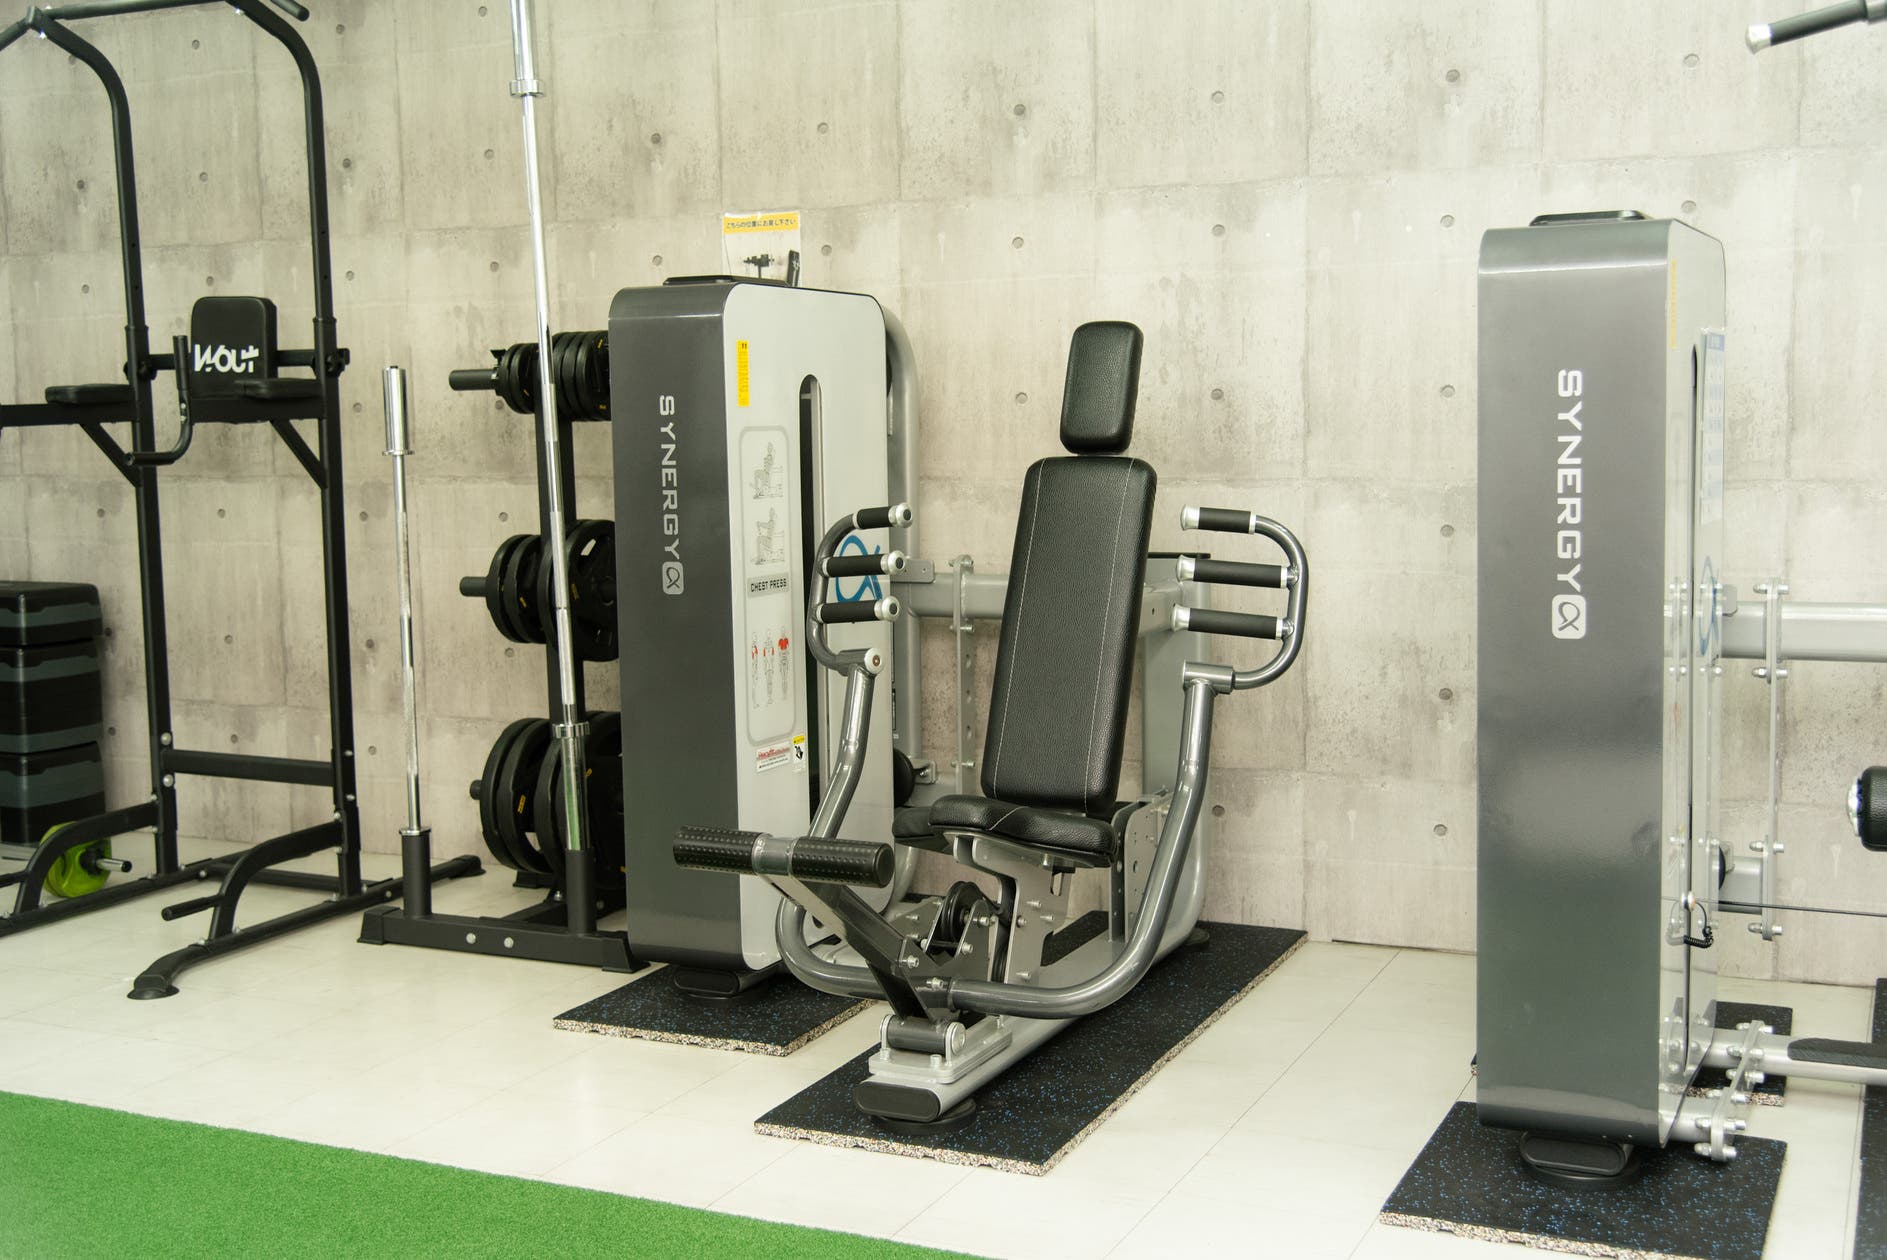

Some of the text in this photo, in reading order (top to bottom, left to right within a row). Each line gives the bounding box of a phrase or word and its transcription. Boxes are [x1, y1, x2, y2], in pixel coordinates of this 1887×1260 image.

[659, 395, 680, 560] SYNERGY
[1556, 369, 1583, 593] SYNERGY
[751, 578, 787, 592] CHEST PRESS
